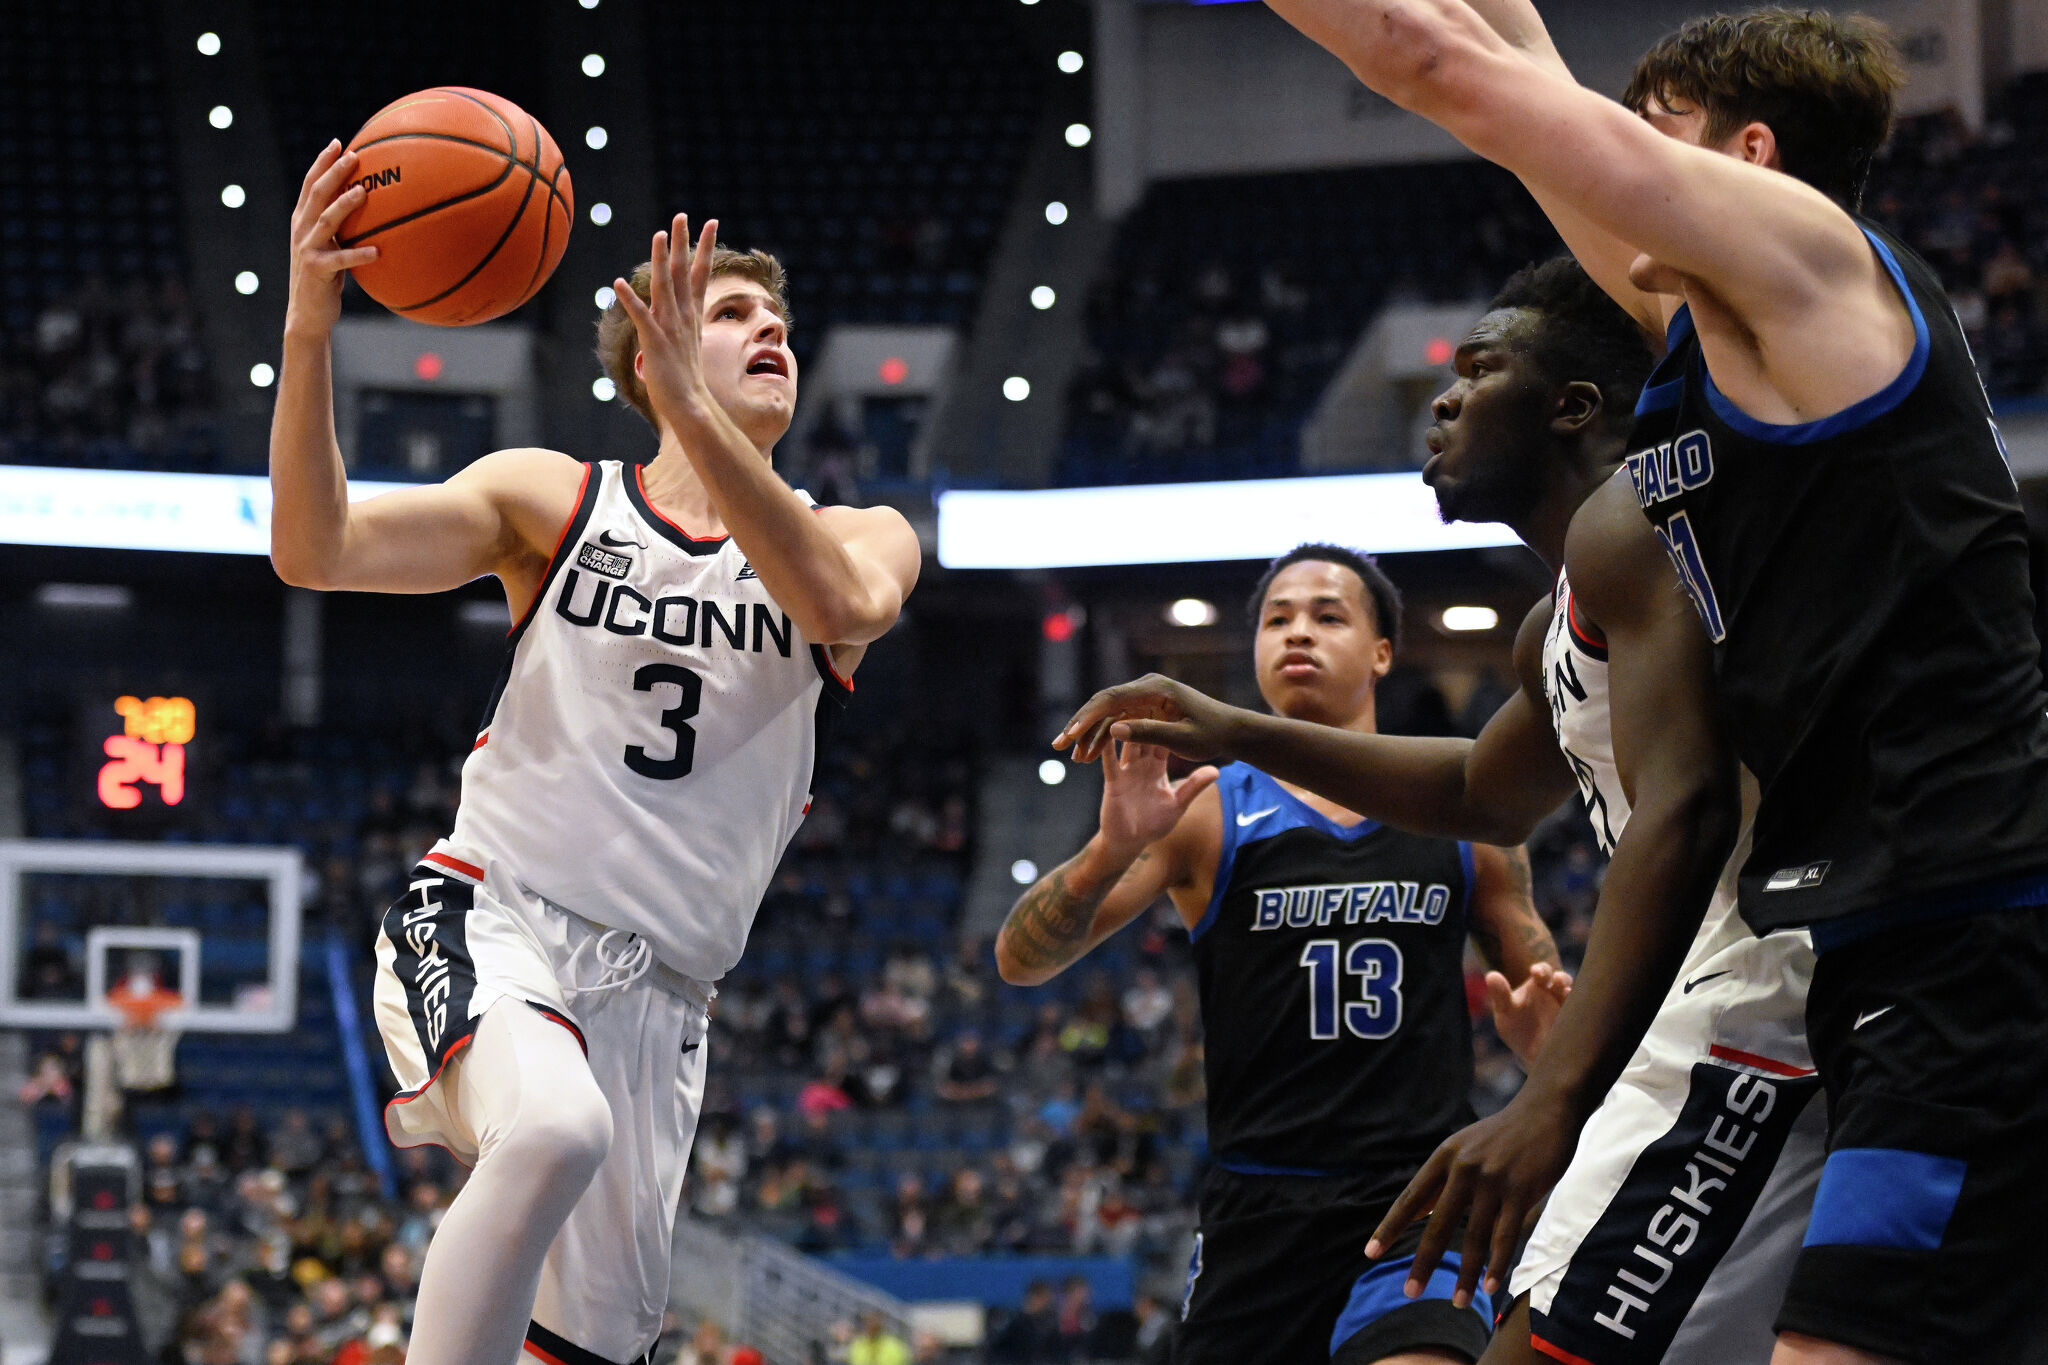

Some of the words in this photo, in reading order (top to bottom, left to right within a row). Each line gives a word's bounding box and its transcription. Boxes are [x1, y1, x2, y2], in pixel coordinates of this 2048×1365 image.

[579, 555, 626, 577] CHANGE
[555, 568, 792, 658] UCONN
[624, 663, 703, 781] 3
[97, 735, 185, 809] 24
[1250, 880, 1451, 932] BUFFALO
[1804, 866, 1820, 880] XL
[1299, 937, 1404, 1041] 13
[1593, 1073, 1777, 1341] HUSKIES
